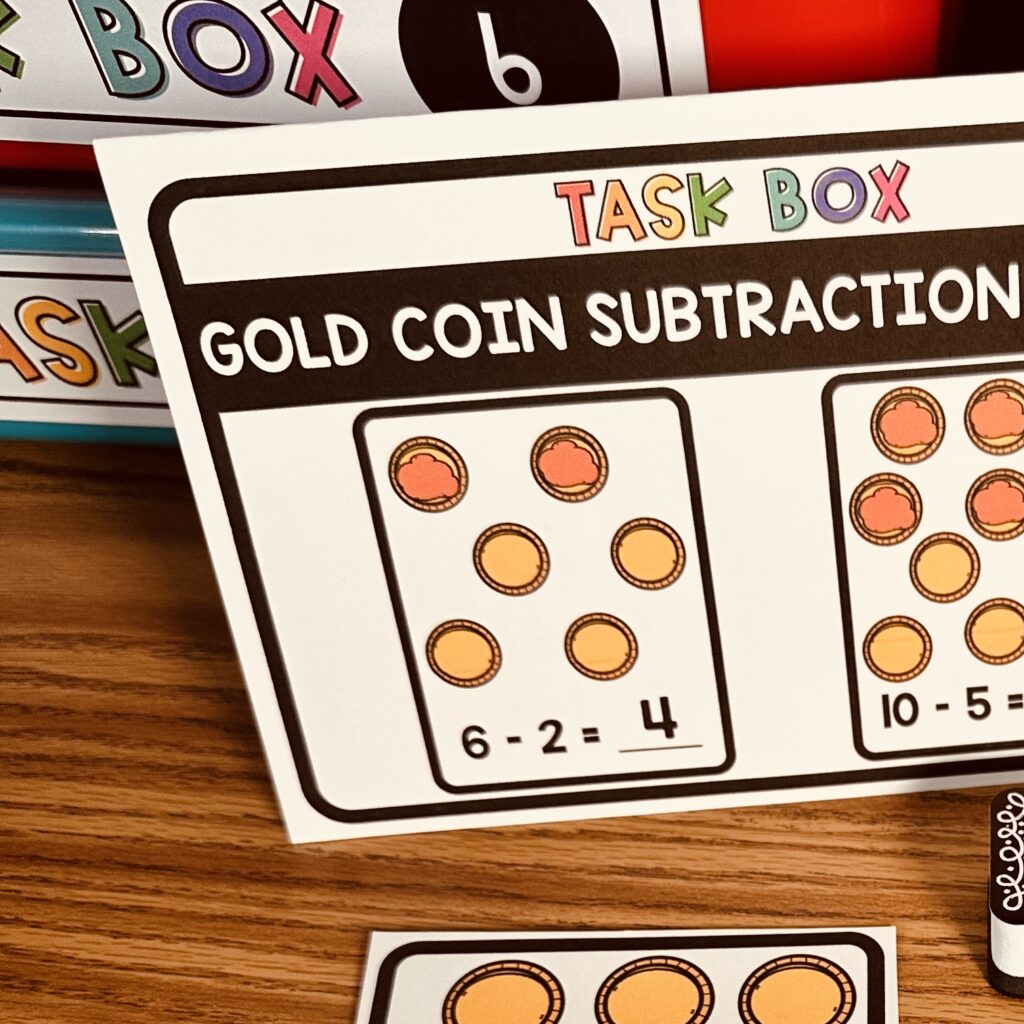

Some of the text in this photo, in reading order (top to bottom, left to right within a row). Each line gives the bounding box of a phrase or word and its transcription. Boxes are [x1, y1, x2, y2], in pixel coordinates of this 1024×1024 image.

[66, 0, 363, 109] BOX
[477, 10, 543, 105] 6
[553, 159, 911, 247] TASK BOX
[199, 313, 369, 377] GOLD
[391, 293, 568, 362] COIN
[585, 261, 1021, 347] SUBTRACTION
[461, 725, 491, 759] 6
[538, 719, 567, 754] 2
[640, 696, 678, 739] 4
[881, 692, 919, 728] 10
[966, 685, 991, 720] 5
